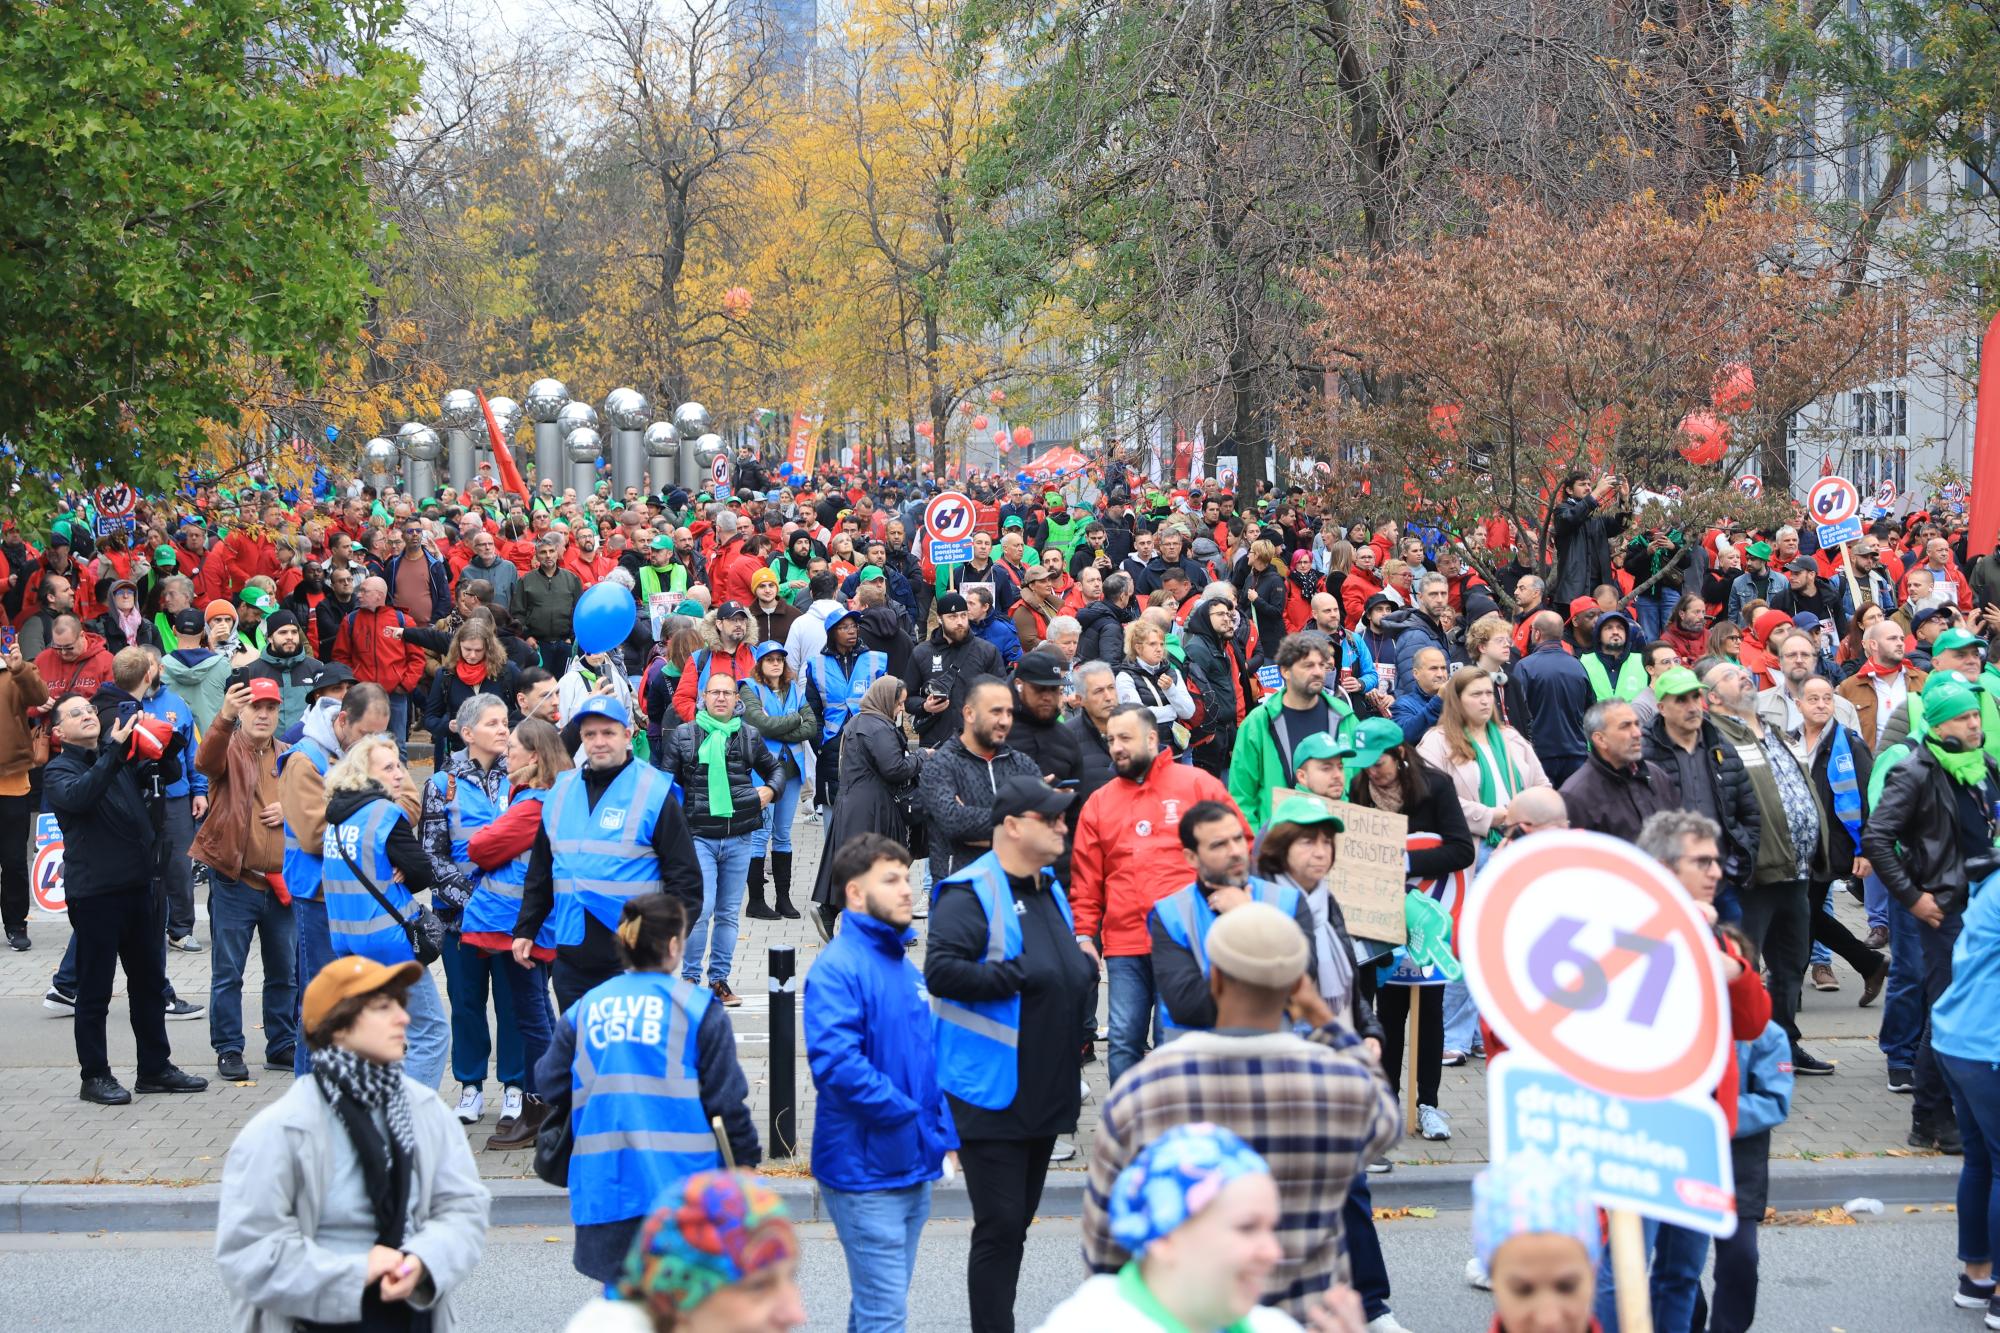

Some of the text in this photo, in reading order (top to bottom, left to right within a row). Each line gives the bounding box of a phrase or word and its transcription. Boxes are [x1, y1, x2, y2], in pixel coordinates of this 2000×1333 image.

[1817, 489, 1845, 514] 67
[935, 508, 965, 530] 67
[953, 553, 965, 561] jaar
[1526, 914, 1677, 1028] 67
[587, 995, 664, 1028] ACLVB
[1514, 1081, 1630, 1130] droit à
[1516, 1109, 1688, 1172] la pension
[1598, 1160, 1661, 1196] ans
